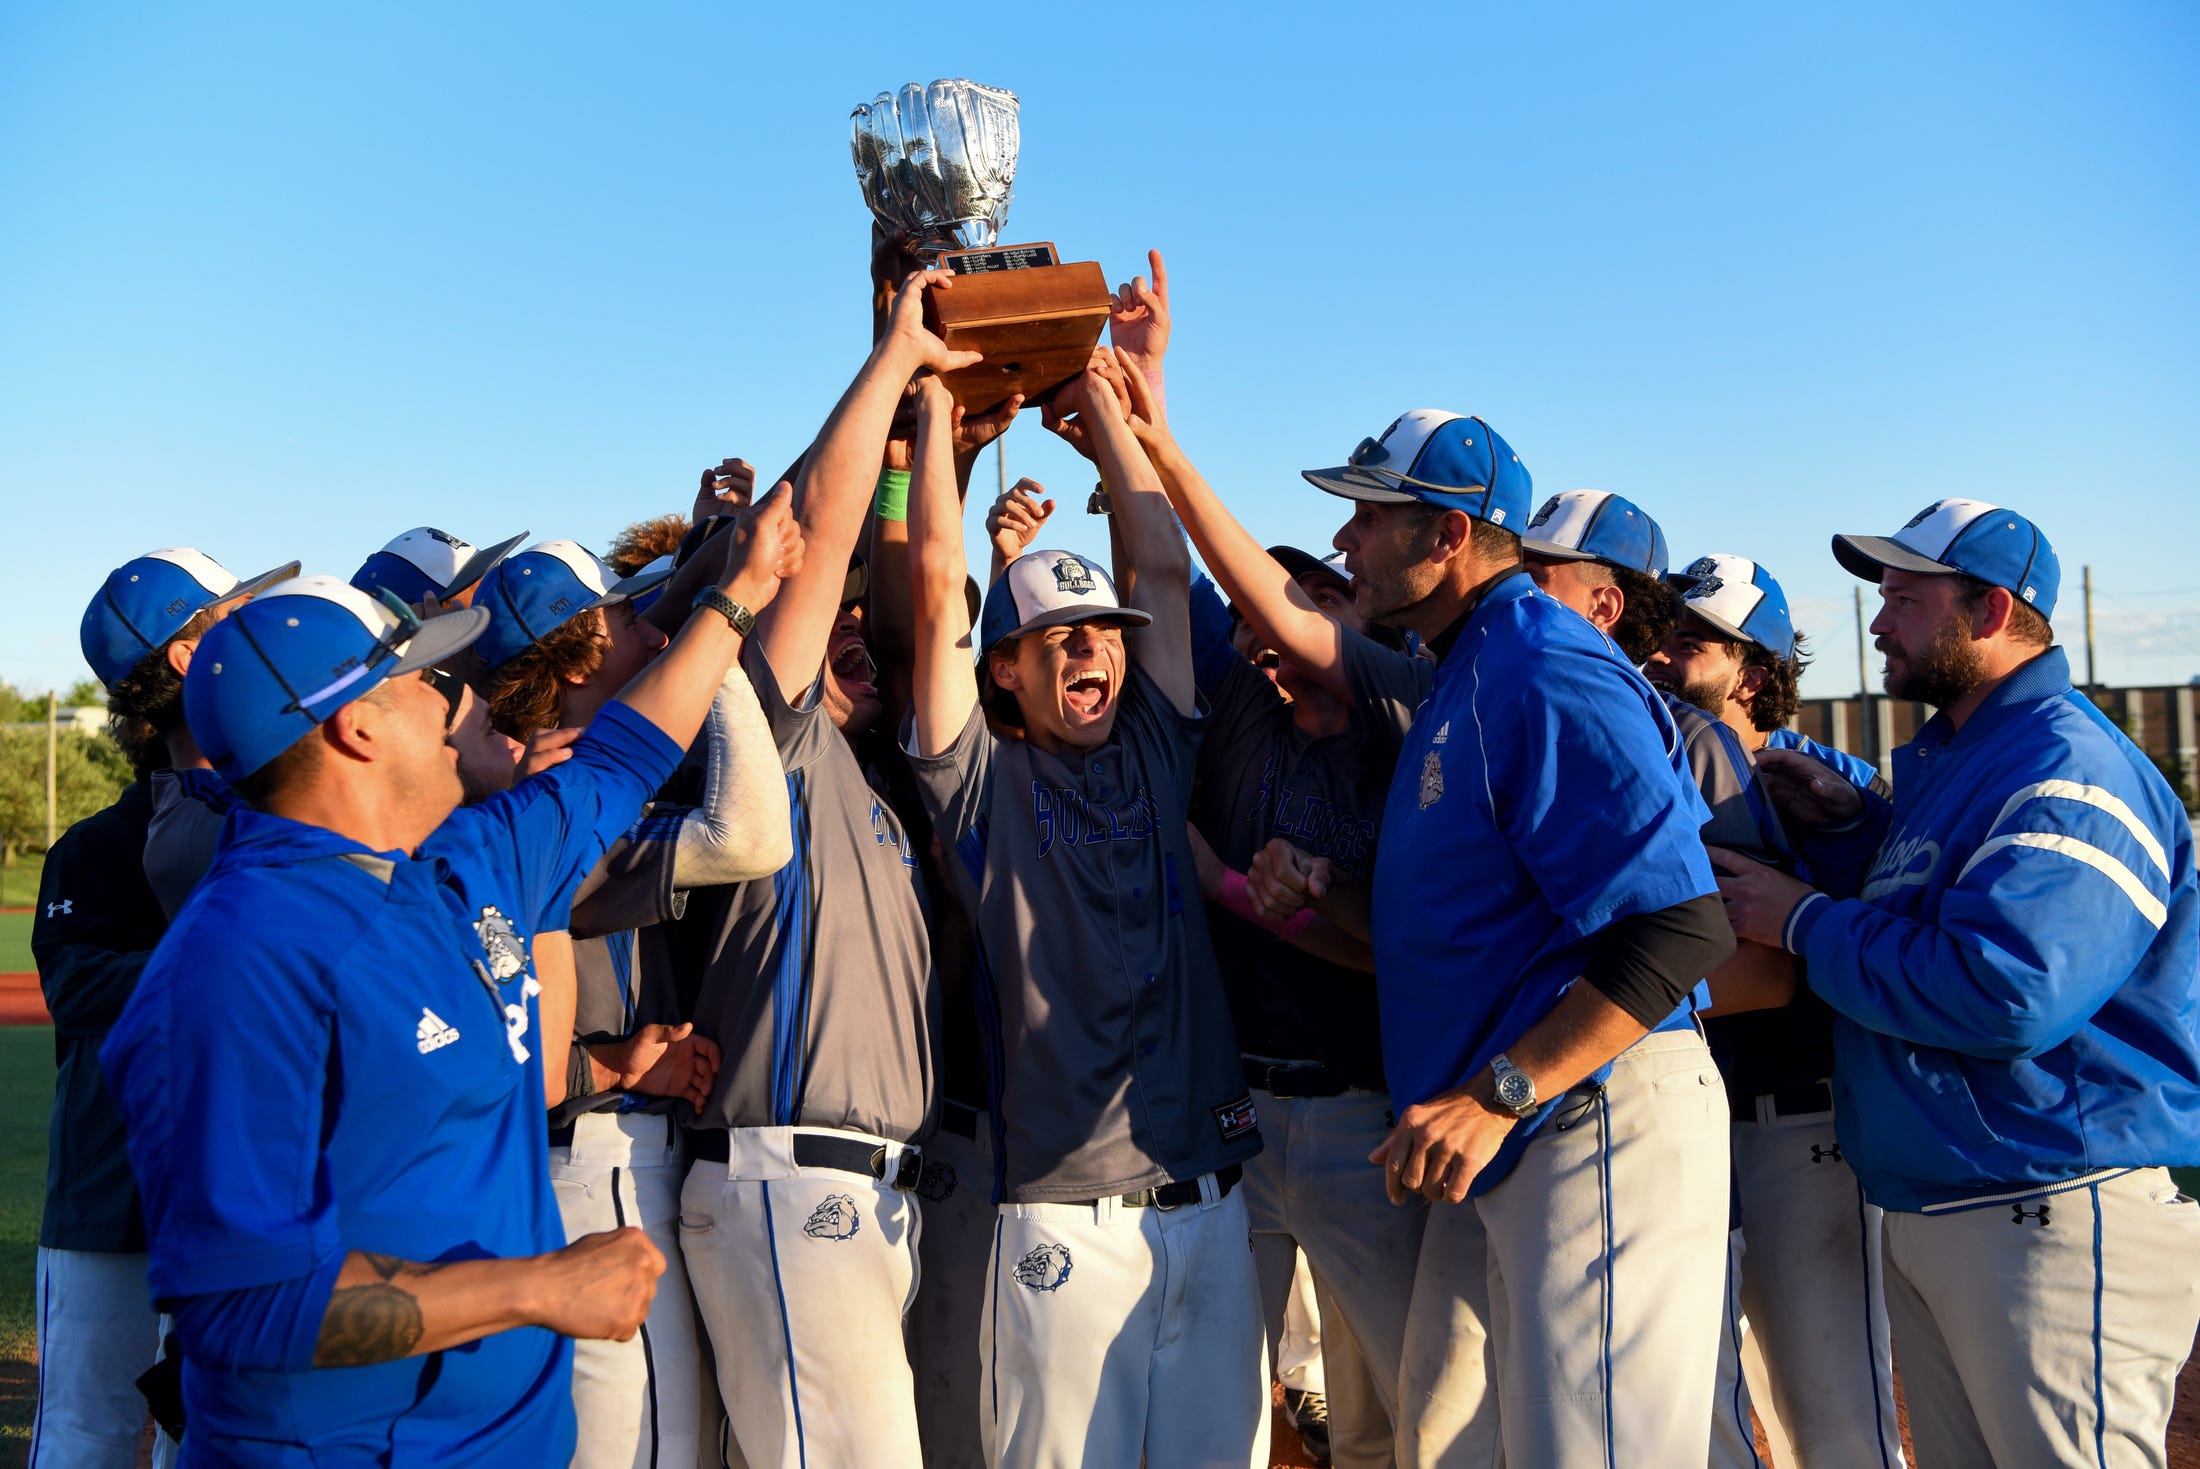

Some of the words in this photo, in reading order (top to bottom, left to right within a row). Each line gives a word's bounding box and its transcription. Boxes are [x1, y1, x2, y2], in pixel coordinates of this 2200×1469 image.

[1059, 579, 1096, 592] BULLDOGS
[165, 598, 189, 618] PCTI
[548, 596, 572, 617] PCTI
